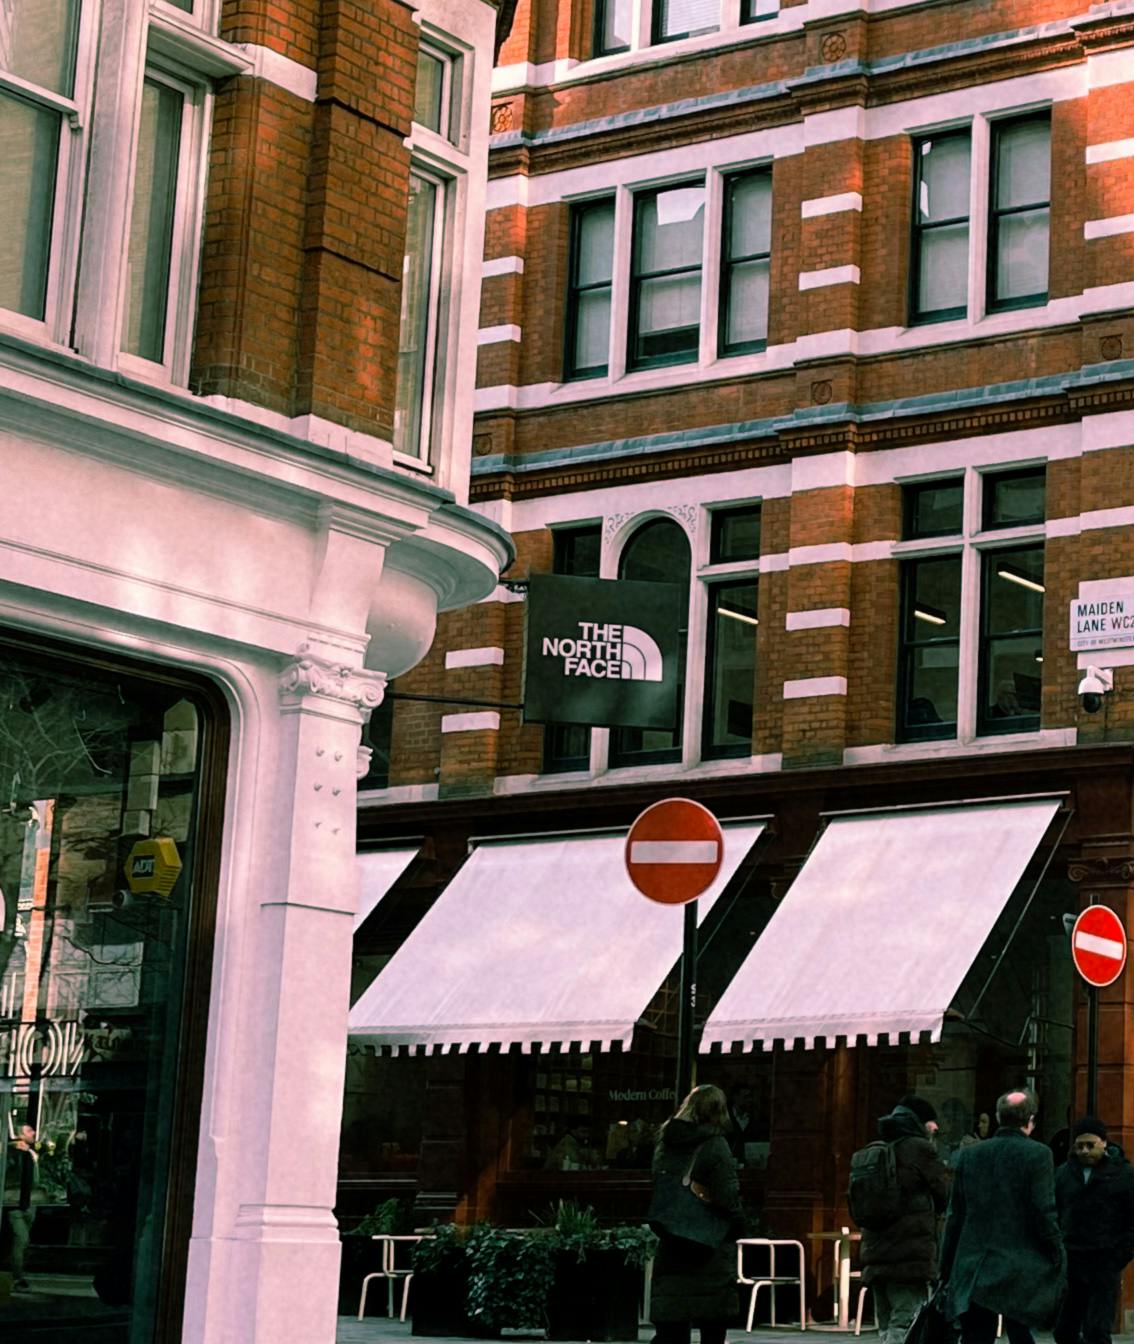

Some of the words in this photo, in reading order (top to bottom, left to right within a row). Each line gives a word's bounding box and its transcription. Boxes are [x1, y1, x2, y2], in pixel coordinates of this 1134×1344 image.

[1077, 601, 1124, 616] MAIDEN
[578, 622, 622, 642] THE
[1077, 618, 1106, 633] LANE
[542, 637, 621, 660] NORTH
[564, 658, 621, 679] FACE
[608, 1088, 647, 1101] Modern
